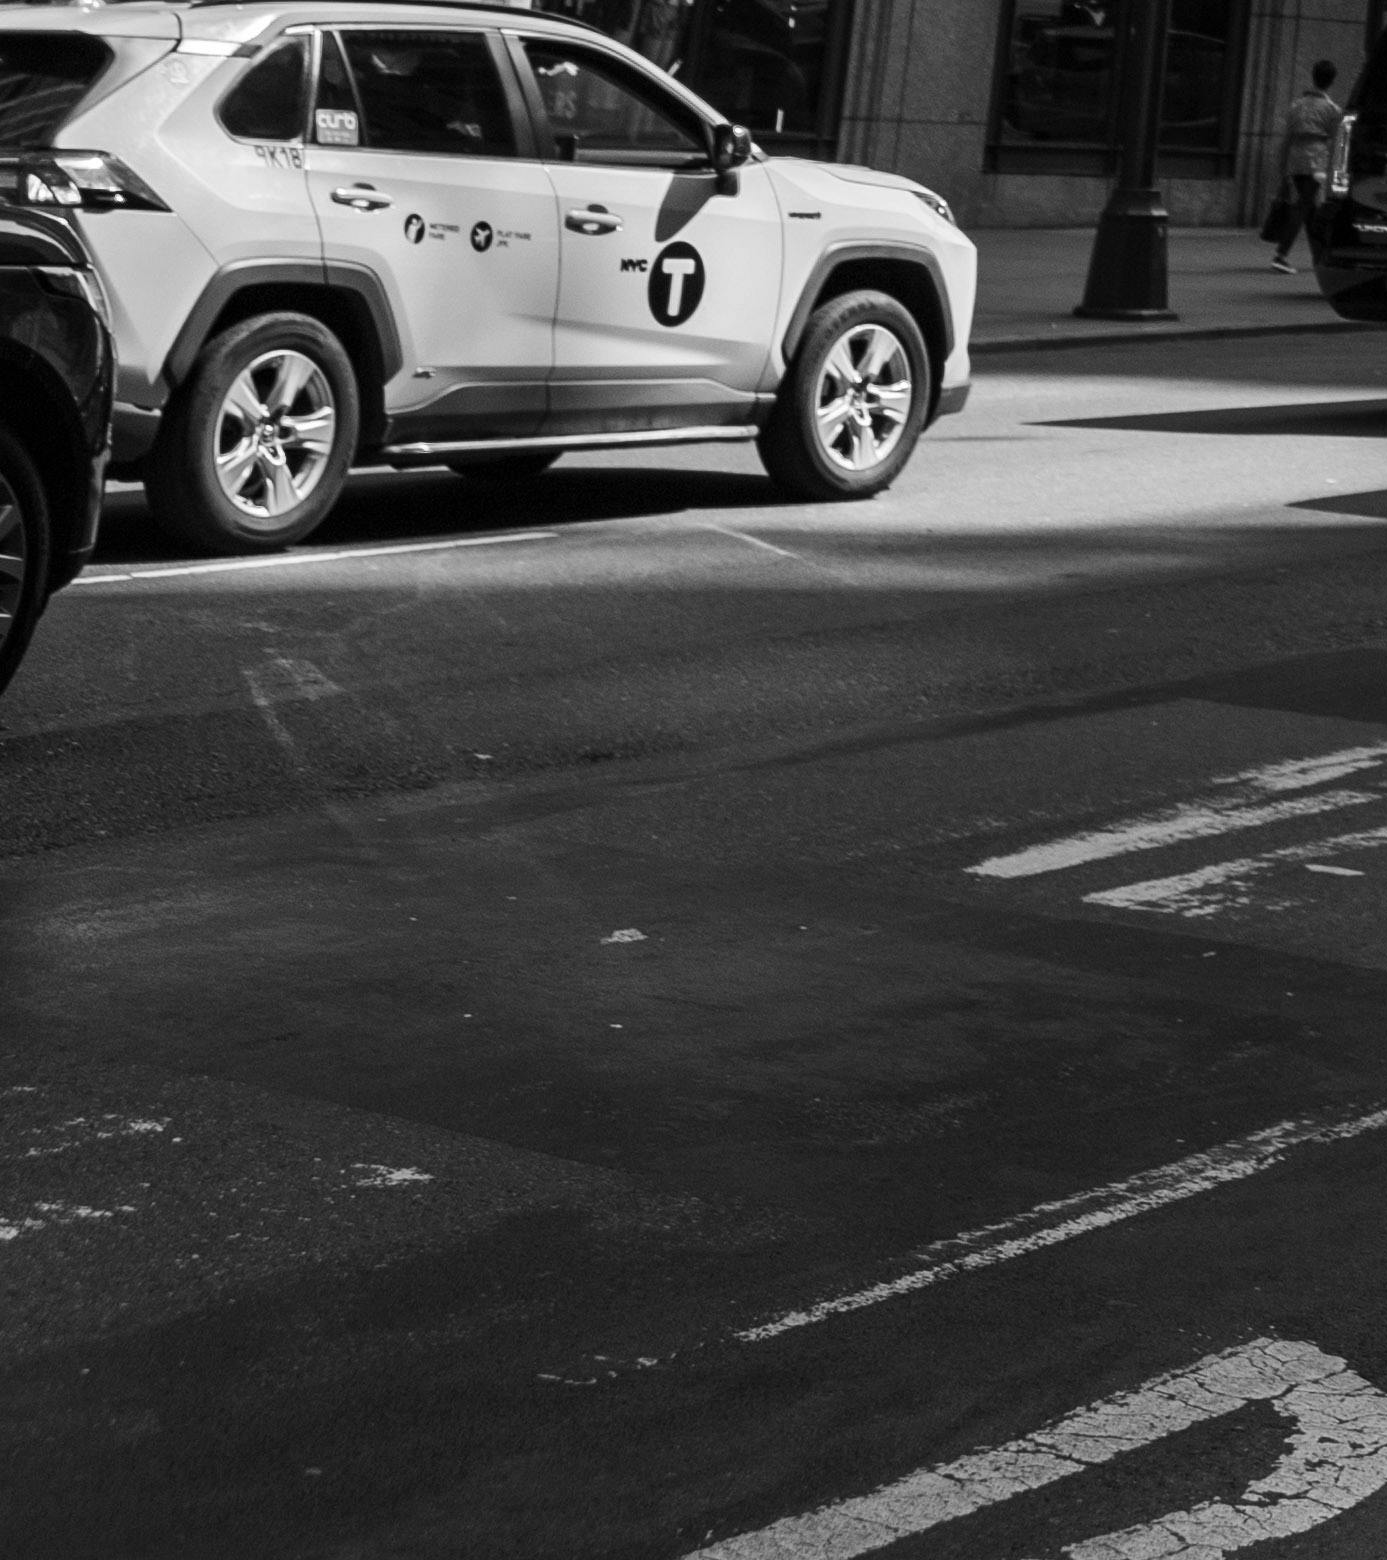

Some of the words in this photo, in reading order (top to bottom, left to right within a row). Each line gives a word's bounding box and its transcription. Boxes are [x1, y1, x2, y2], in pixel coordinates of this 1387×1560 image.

[318, 111, 357, 131] curb
[620, 258, 648, 273] NYC
[661, 258, 696, 317] T
